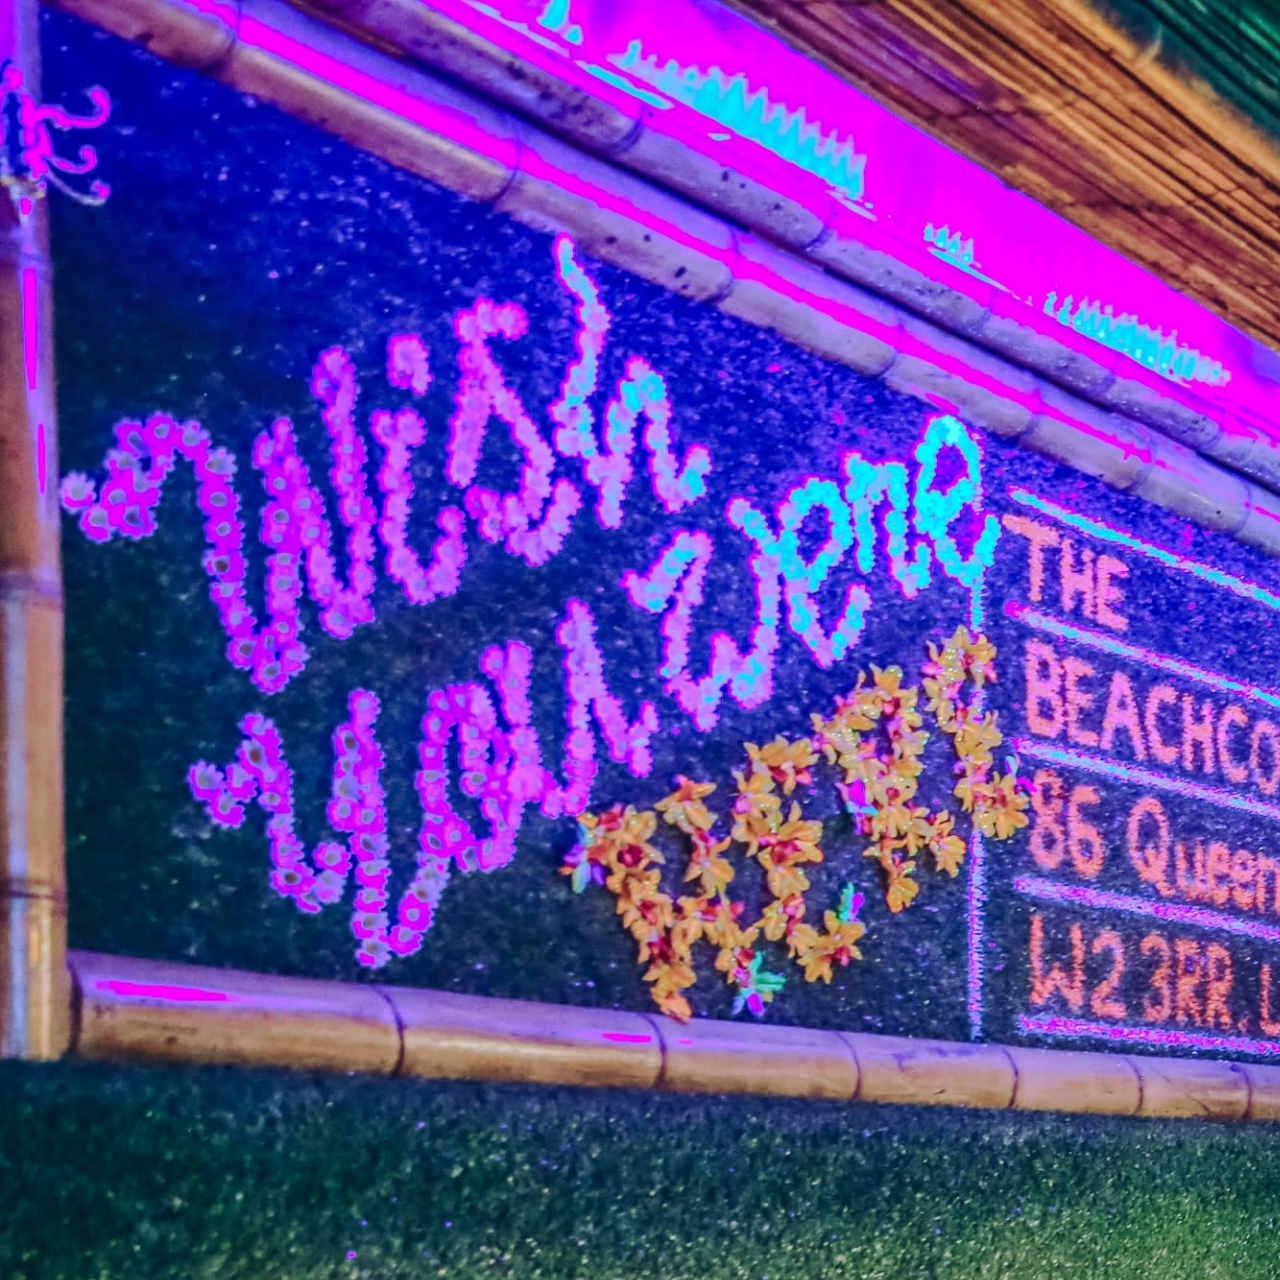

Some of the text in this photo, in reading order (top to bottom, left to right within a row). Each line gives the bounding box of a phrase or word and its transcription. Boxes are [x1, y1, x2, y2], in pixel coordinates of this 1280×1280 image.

[62, 233, 710, 692] Wish
[1001, 513, 1129, 631] THE
[1028, 768, 1104, 879] 86
[1028, 914, 1127, 1019] W2
